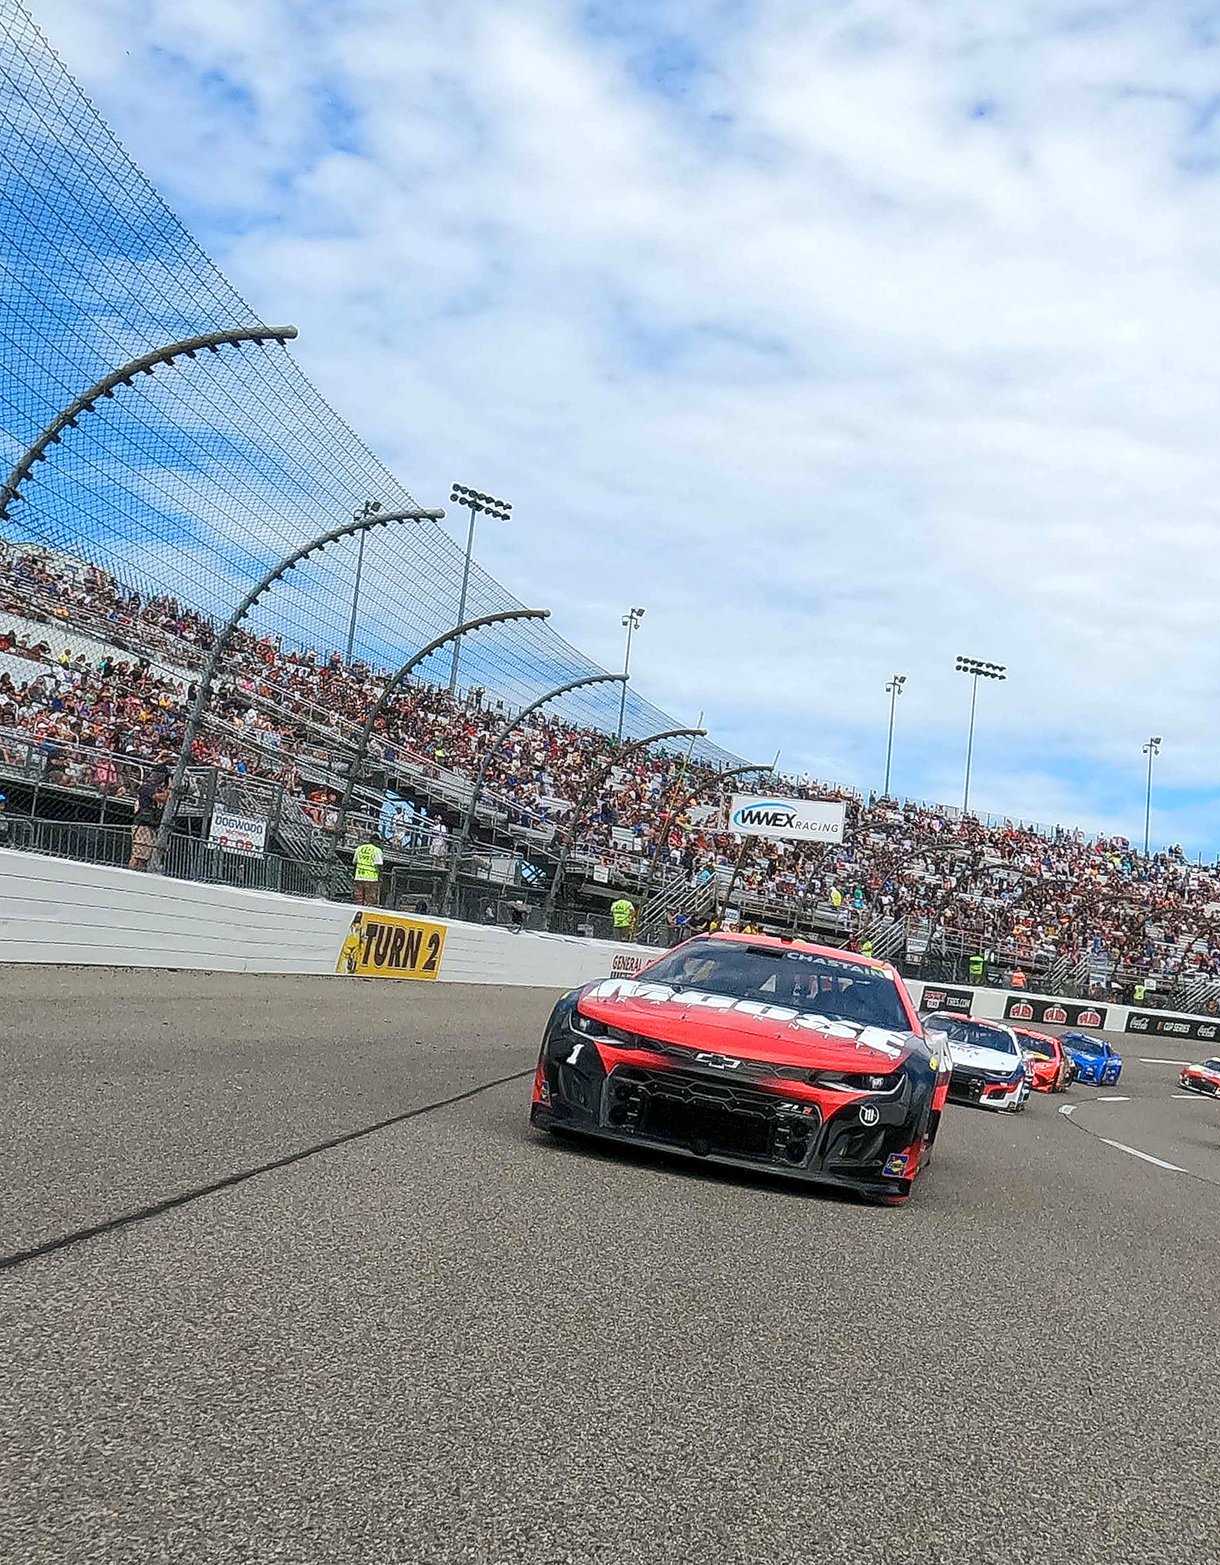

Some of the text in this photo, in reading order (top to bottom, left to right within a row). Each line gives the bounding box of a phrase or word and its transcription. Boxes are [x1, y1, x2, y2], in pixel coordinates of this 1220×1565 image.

[795, 821, 839, 833] RACING
[361, 922, 442, 972] TURN 2
[612, 955, 643, 971] GENERAL
[786, 951, 886, 979] CHASTAIN
[566, 1043, 585, 1065] 1
